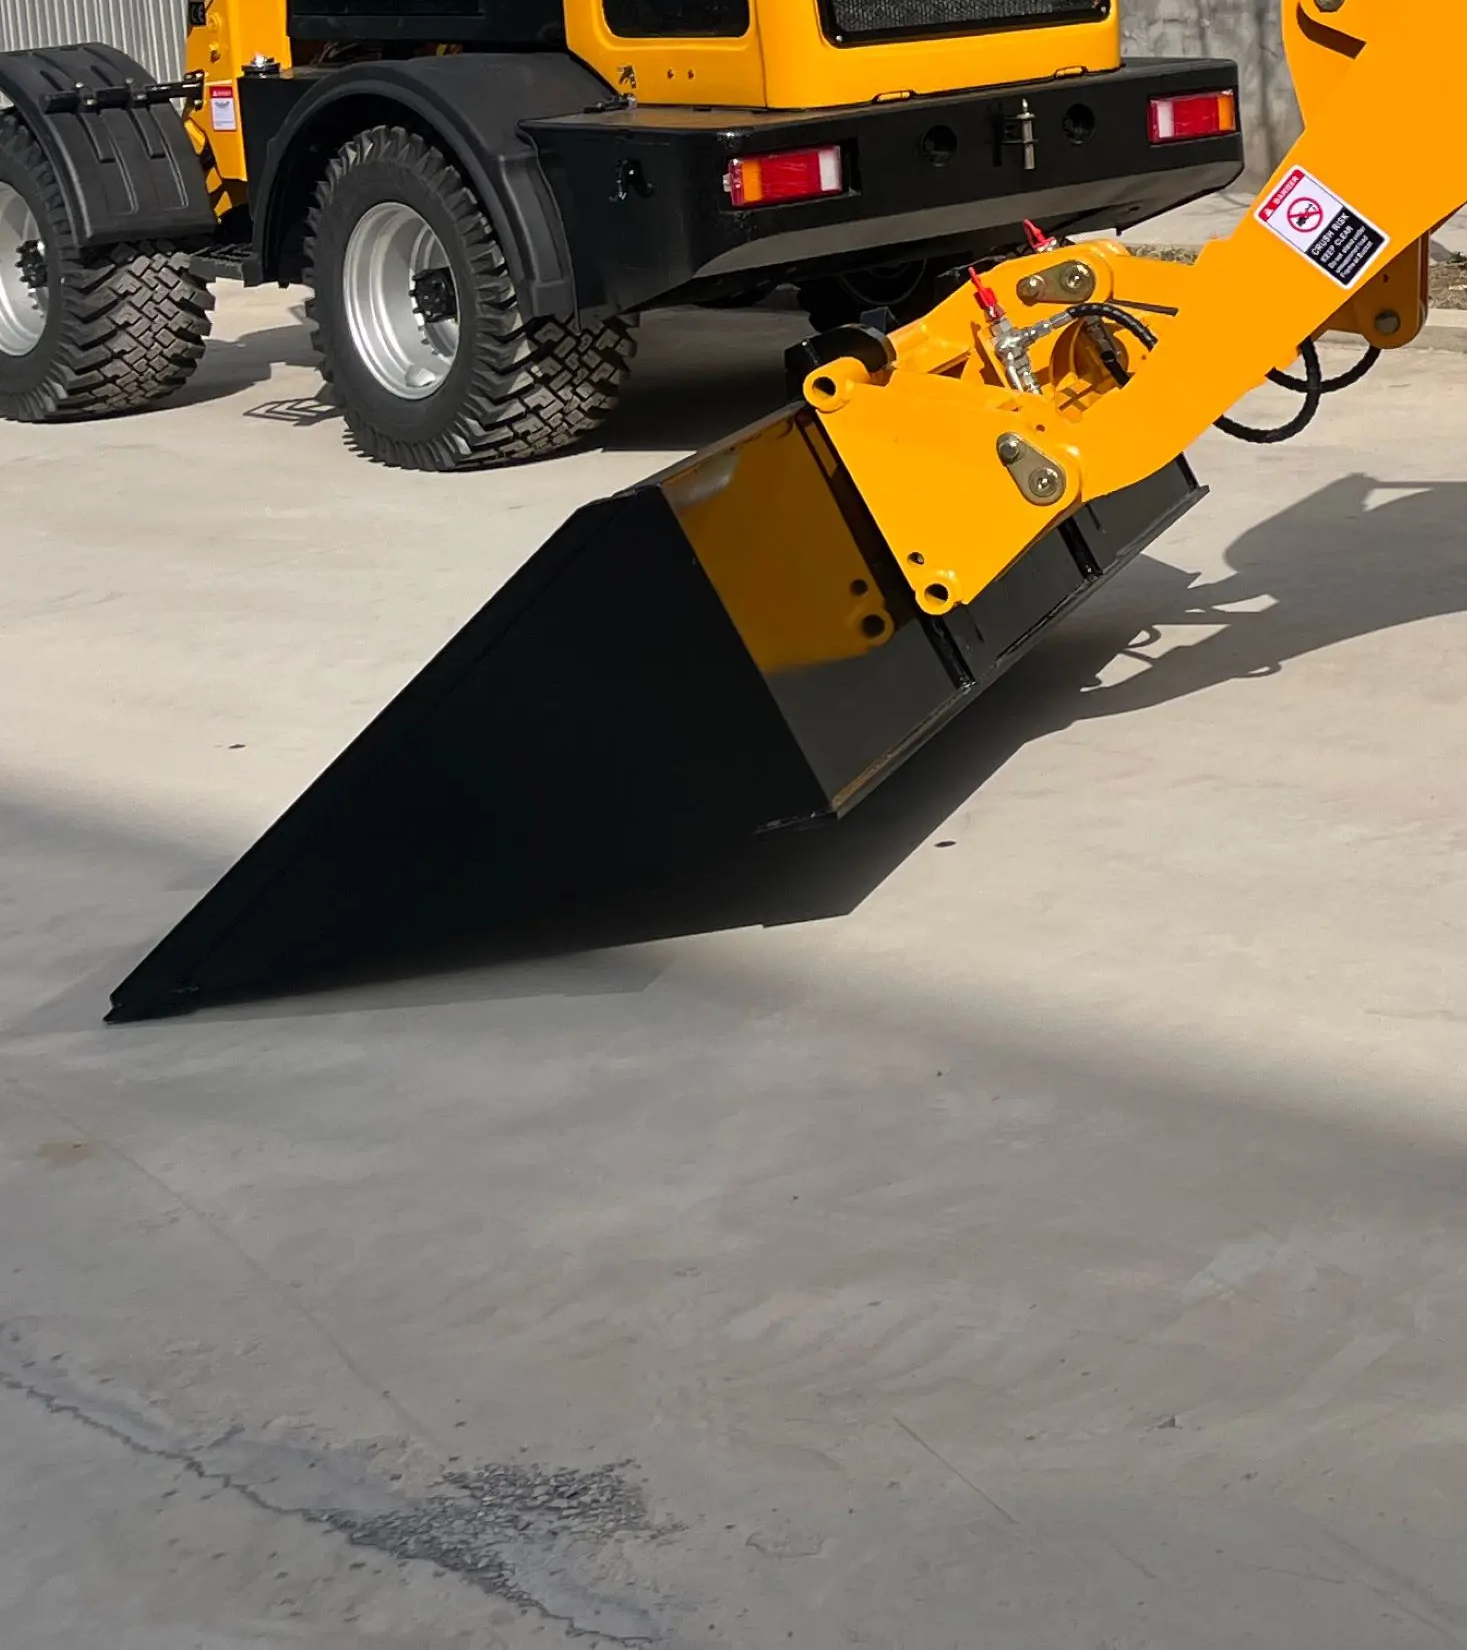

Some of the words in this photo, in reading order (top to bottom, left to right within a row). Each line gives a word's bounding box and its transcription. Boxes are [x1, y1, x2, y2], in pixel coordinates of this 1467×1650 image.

[1272, 175, 1299, 205] DANGER
[1311, 230, 1335, 256] CRUSH
[1331, 212, 1350, 231] RISK
[1320, 245, 1335, 263] KEEP
[1334, 225, 1354, 246] CLEAR
